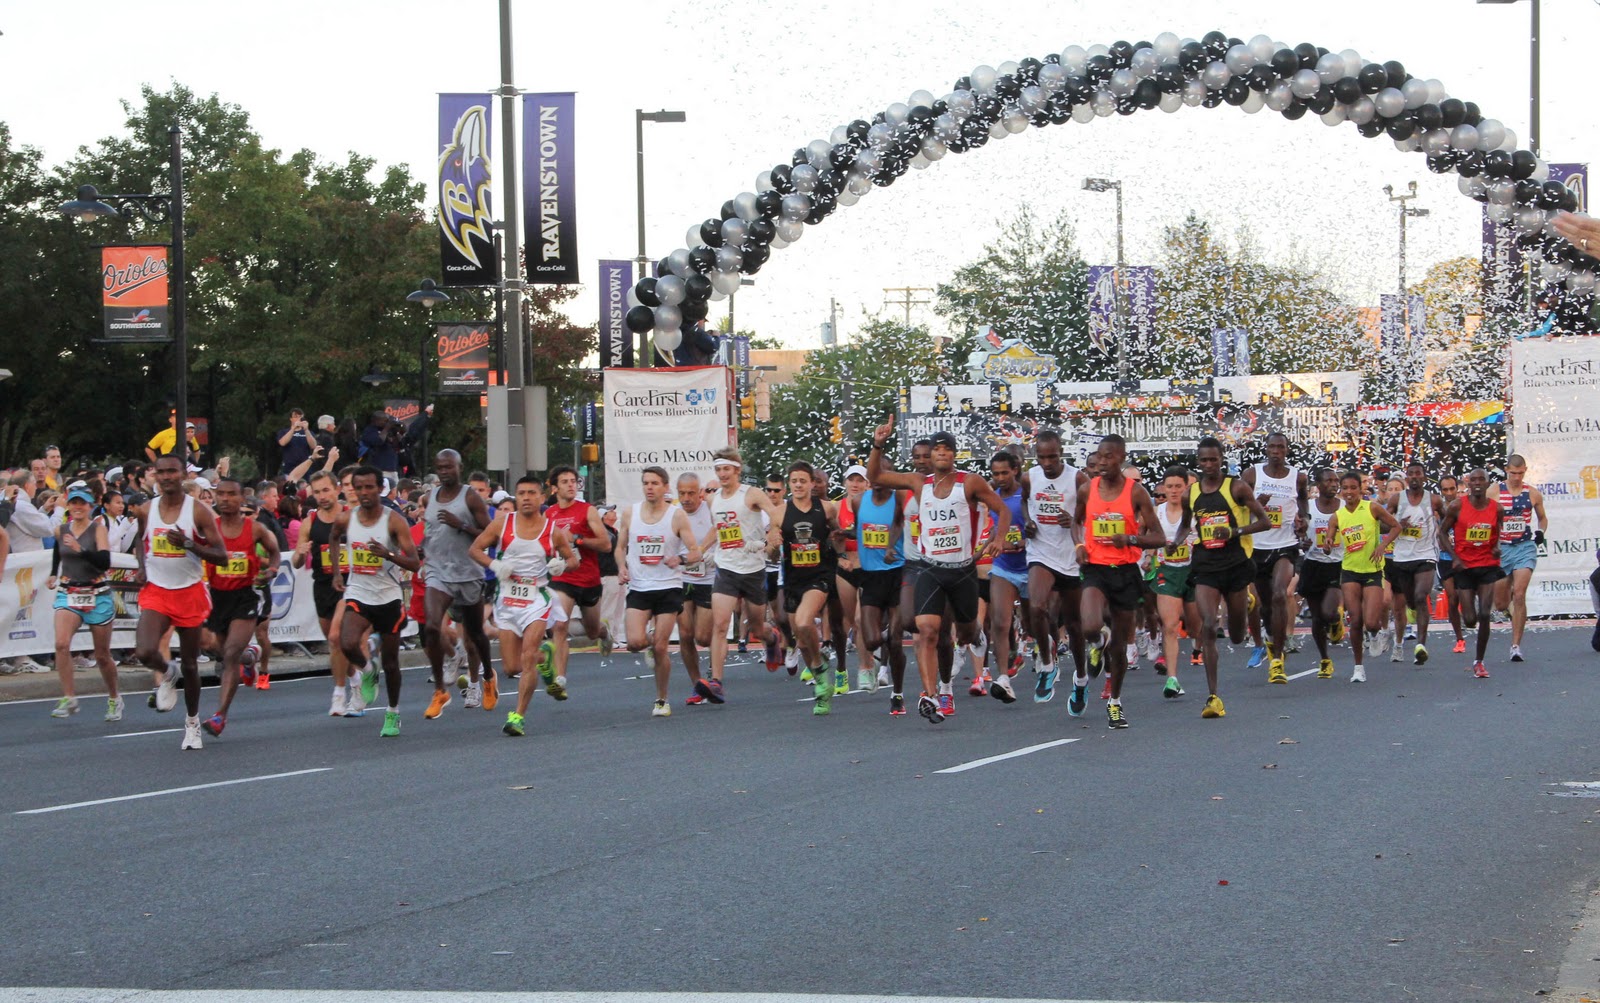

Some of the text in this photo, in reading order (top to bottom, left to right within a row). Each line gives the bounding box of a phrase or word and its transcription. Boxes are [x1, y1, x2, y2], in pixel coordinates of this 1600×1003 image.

[539, 105, 562, 262] RAVENSTOWN
[102, 255, 168, 292] Orioles
[446, 264, 476, 272] Coca-Cola
[536, 264, 566, 272] Coca-Cola
[609, 267, 624, 367] RAVENSTOWN
[110, 322, 162, 330] SOUTHWEST.COM
[437, 330, 490, 357] Orioles
[1522, 357, 1594, 377] CareFirst
[613, 389, 683, 407] CareFirst
[614, 406, 718, 418] BlueCross BlueShield
[1282, 406, 1344, 426] PROTECT
[1101, 414, 1168, 439] BALTIMORE
[1526, 420, 1569, 435] LEGG
[617, 449, 715, 464] LEGG MASON
[1261, 482, 1293, 491] MARATHON
[1039, 503, 1061, 514] 4255
[928, 509, 957, 521] USA
[1268, 514, 1279, 523] 24
[1099, 523, 1117, 533] M 1
[1204, 527, 1214, 537] M
[1506, 523, 1523, 531] 3421
[720, 529, 739, 540] M 12
[864, 533, 885, 543] M 13
[1410, 529, 1420, 538] 22
[1469, 530, 1487, 539] M 21
[933, 536, 958, 548] 4233
[1553, 538, 1591, 554] M&T
[640, 544, 661, 554] 1277
[356, 552, 379, 564] M 23
[795, 552, 816, 562] M 19
[232, 561, 245, 572] 20
